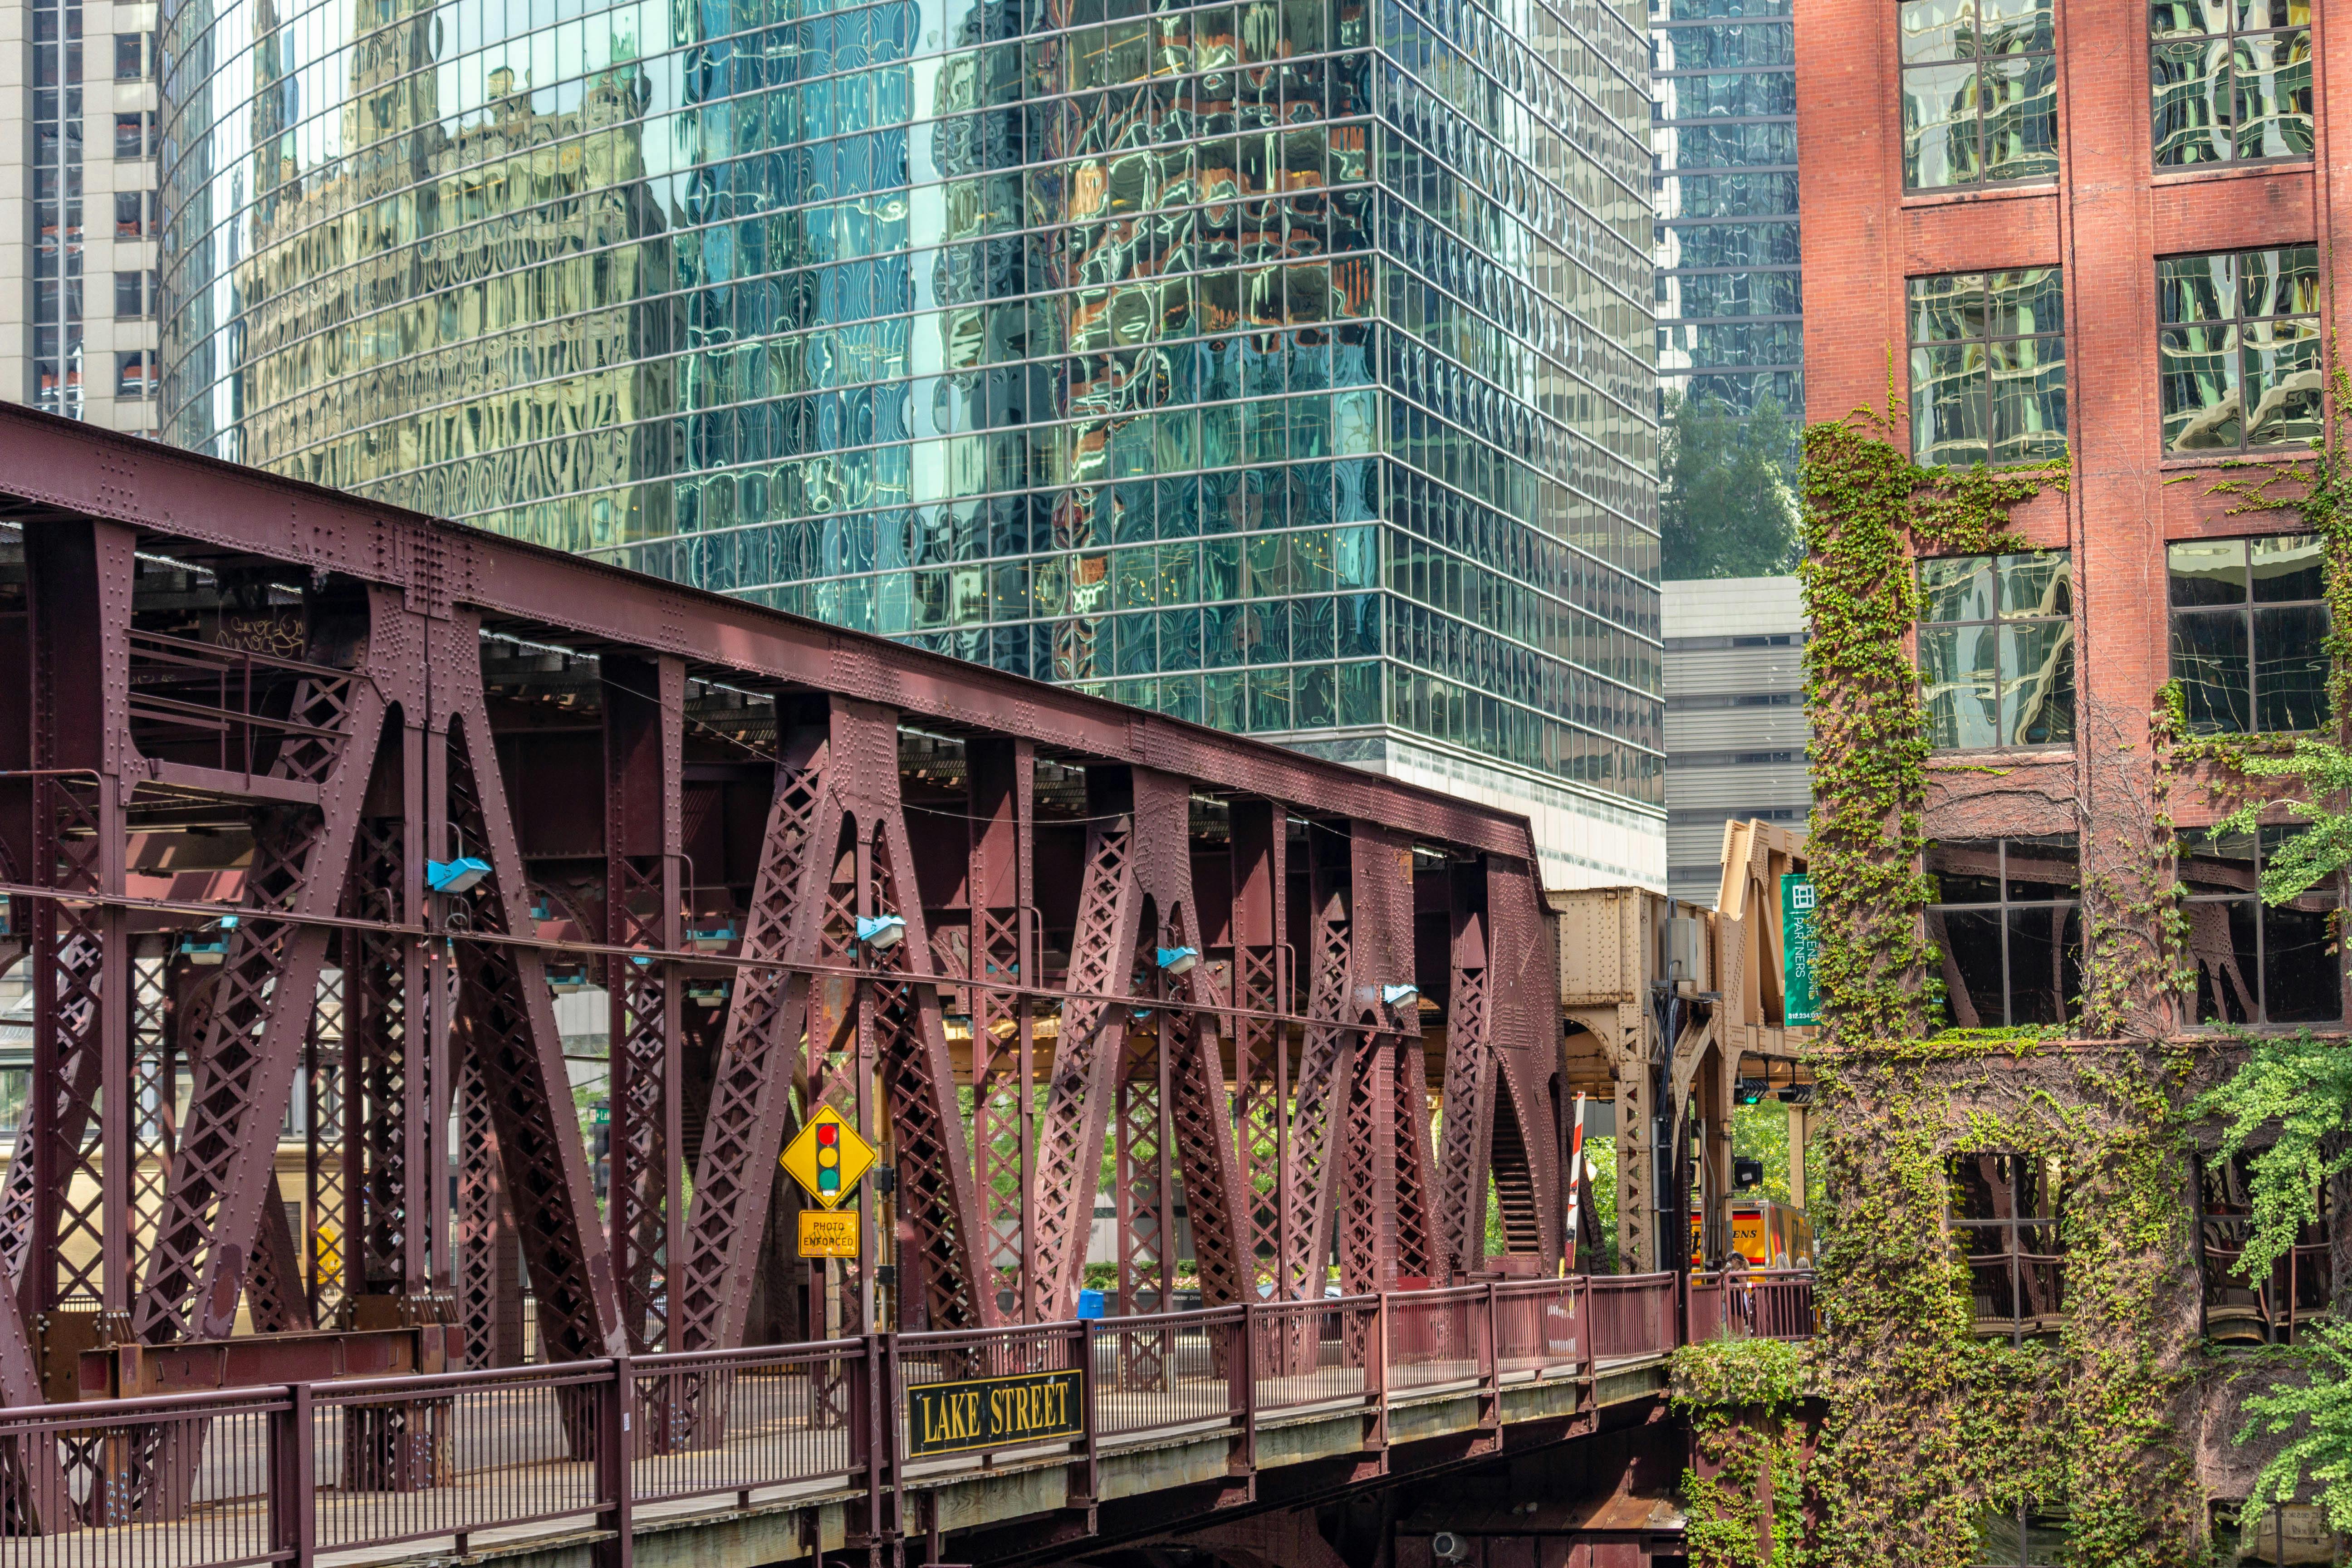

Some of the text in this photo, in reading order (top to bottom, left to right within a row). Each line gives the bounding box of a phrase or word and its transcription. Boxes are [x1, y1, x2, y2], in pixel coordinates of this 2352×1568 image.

[1794, 917, 1806, 978] PARTNERS
[1807, 916, 1818, 996] RENTONE
[804, 1237, 853, 1246] ENFORCED
[813, 1222, 844, 1230] PHOTO
[922, 1392, 980, 1443] LAKE
[991, 1382, 1068, 1435] STREET
